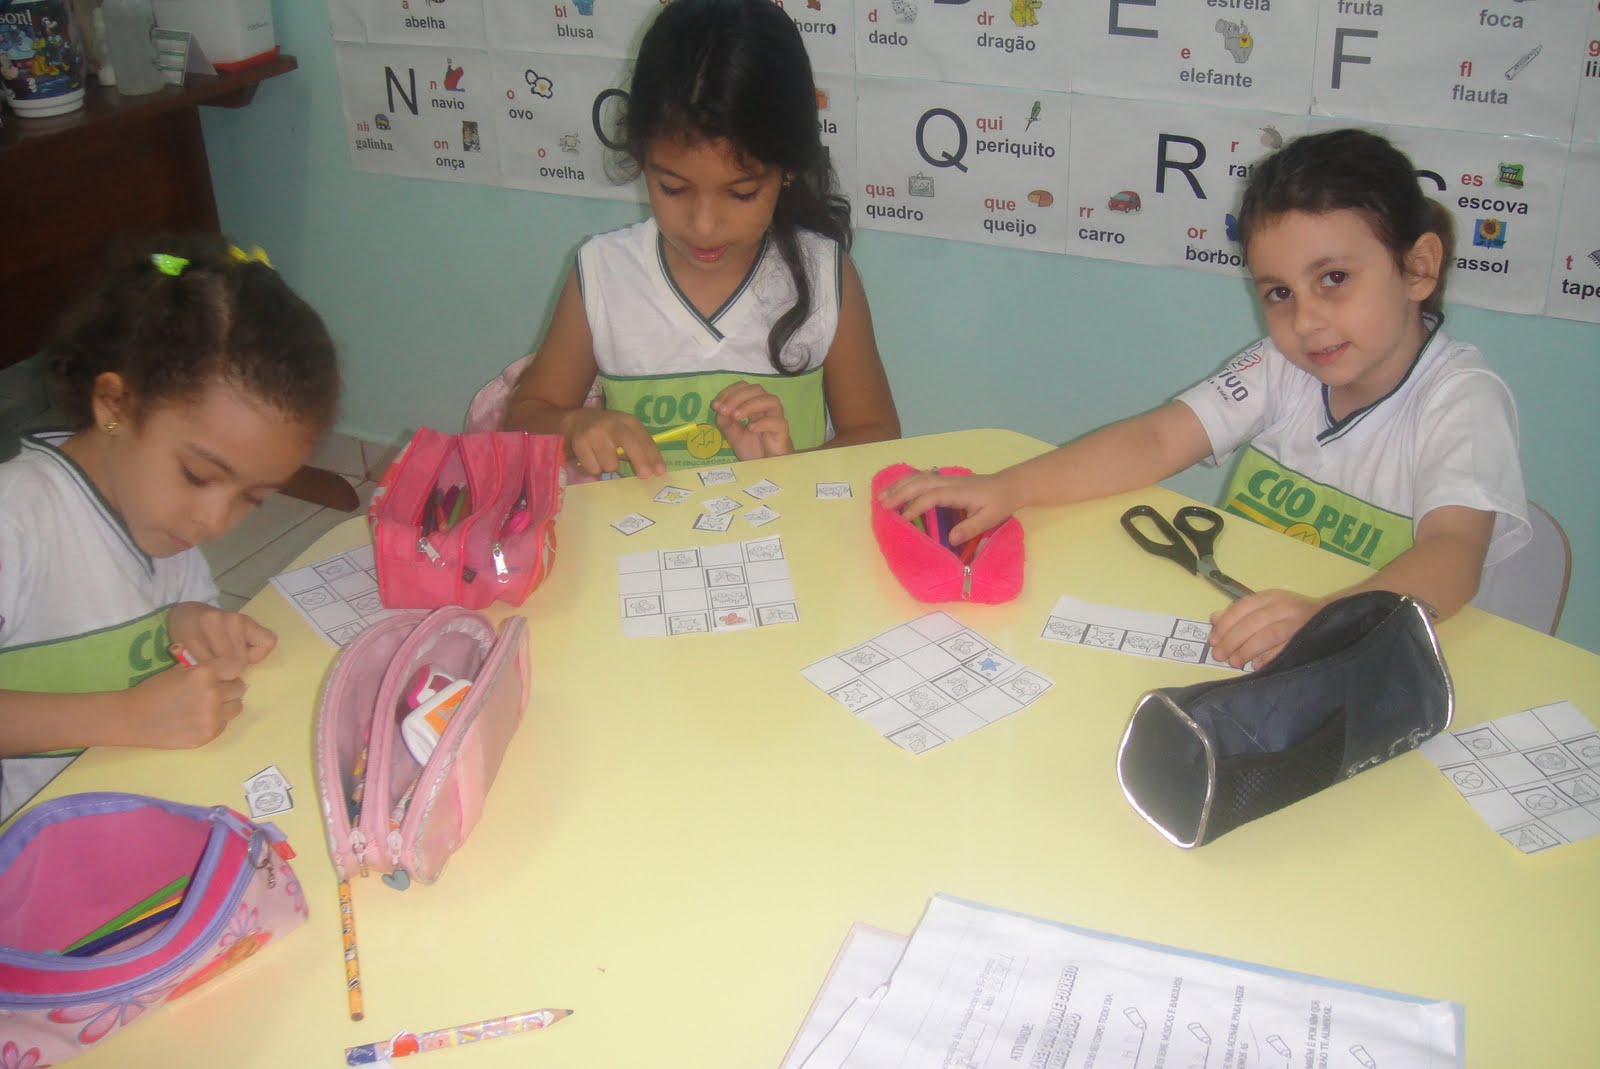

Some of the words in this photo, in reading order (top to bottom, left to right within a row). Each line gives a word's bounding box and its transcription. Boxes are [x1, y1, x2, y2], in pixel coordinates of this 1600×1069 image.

[555, 5, 567, 18] bl
[868, 9, 877, 22] d
[1338, 0, 1383, 17] fruta
[405, 16, 446, 29] abelha
[977, 11, 995, 26] dr
[1479, 9, 1524, 28] foca
[557, 24, 594, 39] blusa
[868, 30, 908, 46] dado
[977, 32, 1036, 53] dragão
[1180, 48, 1191, 59] e
[1331, 27, 1378, 89] F
[1459, 61, 1473, 77] fl
[1586, 60, 1600, 78] li
[430, 80, 437, 90] n
[1180, 68, 1253, 88] elefante
[385, 66, 419, 115] N
[506, 89, 515, 100] o
[1452, 85, 1508, 105] flauta
[431, 97, 465, 110] navio
[509, 108, 534, 121] ovo
[357, 121, 370, 132] nh
[976, 116, 1003, 133] qui
[355, 138, 393, 152] galinha
[433, 139, 449, 149] on
[915, 108, 968, 174] Q
[976, 138, 1056, 159] periquito
[1231, 141, 1239, 152] r
[538, 148, 546, 158] o
[436, 156, 465, 170] onça
[1156, 133, 1207, 200] R
[540, 166, 585, 181] ovelha
[1461, 172, 1483, 187] es
[865, 183, 895, 199] qua
[984, 196, 1016, 213] que
[1457, 195, 1529, 215] escova
[866, 203, 924, 222] quadro
[1079, 206, 1094, 219] rr
[983, 216, 1037, 237] queijo
[1187, 226, 1207, 240] or
[1078, 227, 1126, 245] carro
[1453, 257, 1509, 274] assol
[1566, 255, 1573, 270] t
